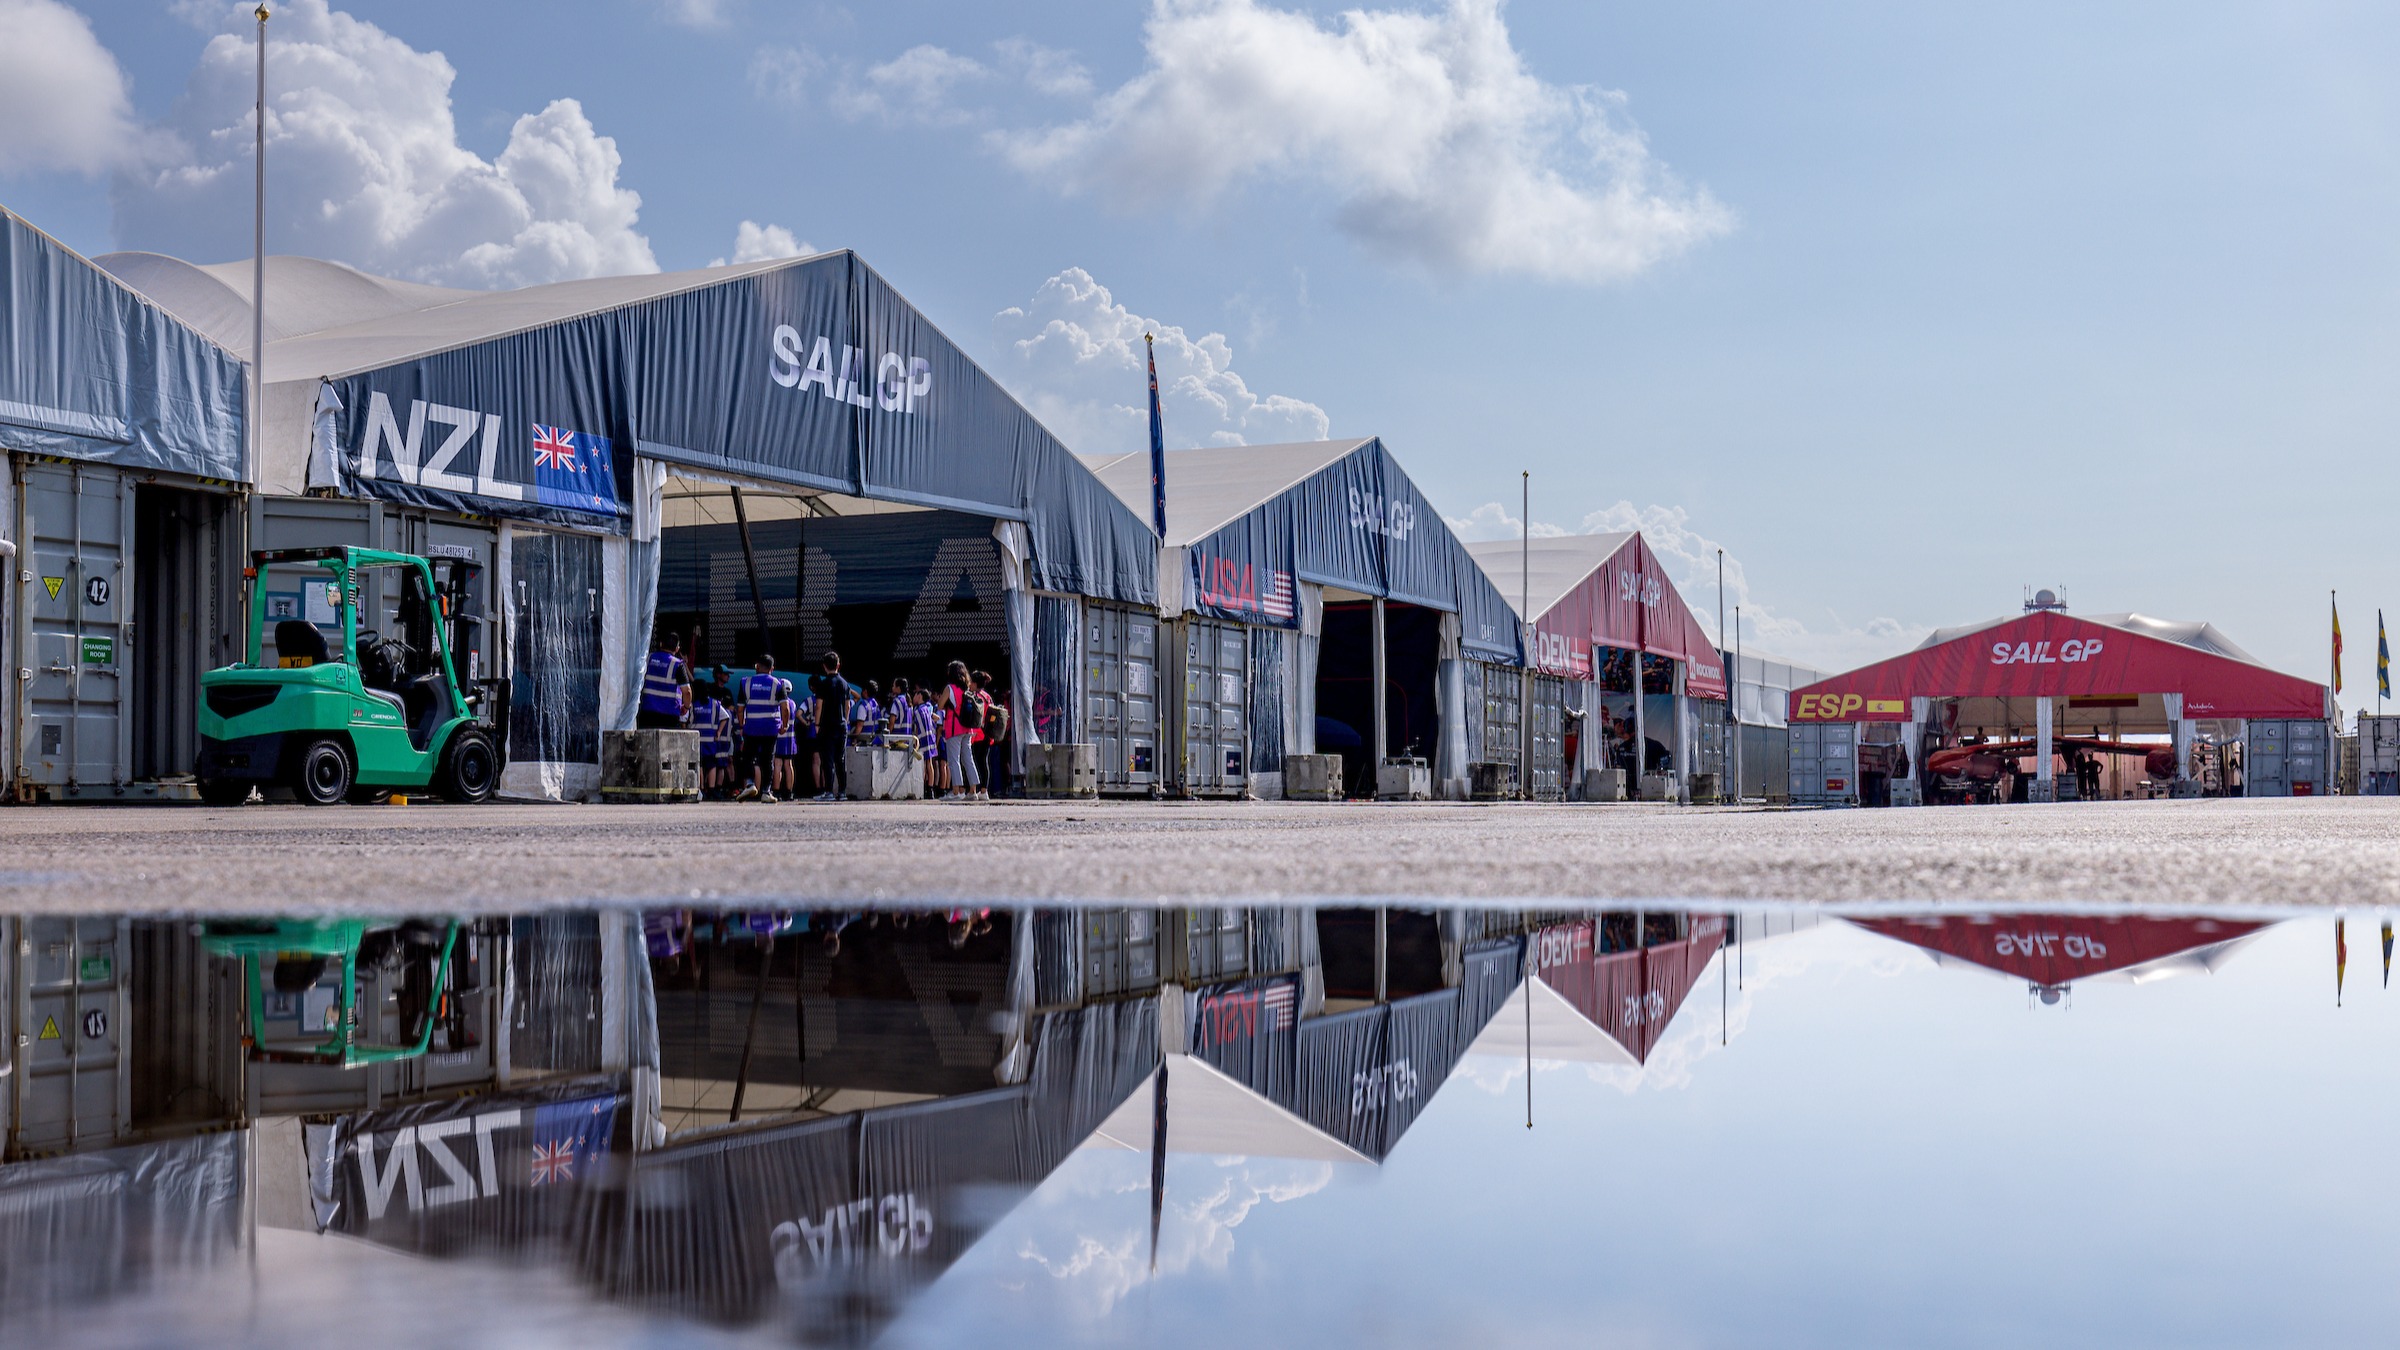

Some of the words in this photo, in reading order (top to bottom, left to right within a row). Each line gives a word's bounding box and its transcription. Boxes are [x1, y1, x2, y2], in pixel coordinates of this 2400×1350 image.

[769, 323, 872, 408] SAIL
[877, 351, 932, 415] GP
[360, 390, 522, 500] NZL
[1349, 486, 1389, 537] SAIL
[1390, 499, 1415, 542] GP
[91, 580, 107, 602] 42
[1200, 553, 1258, 614] USA
[83, 643, 112, 651] CHANGING
[1539, 631, 1570, 669] DEN
[1991, 641, 2056, 665] SAIL
[2060, 638, 2104, 663] GP
[1696, 662, 1721, 679] ROCKWOOL
[1796, 693, 1863, 719] ESP
